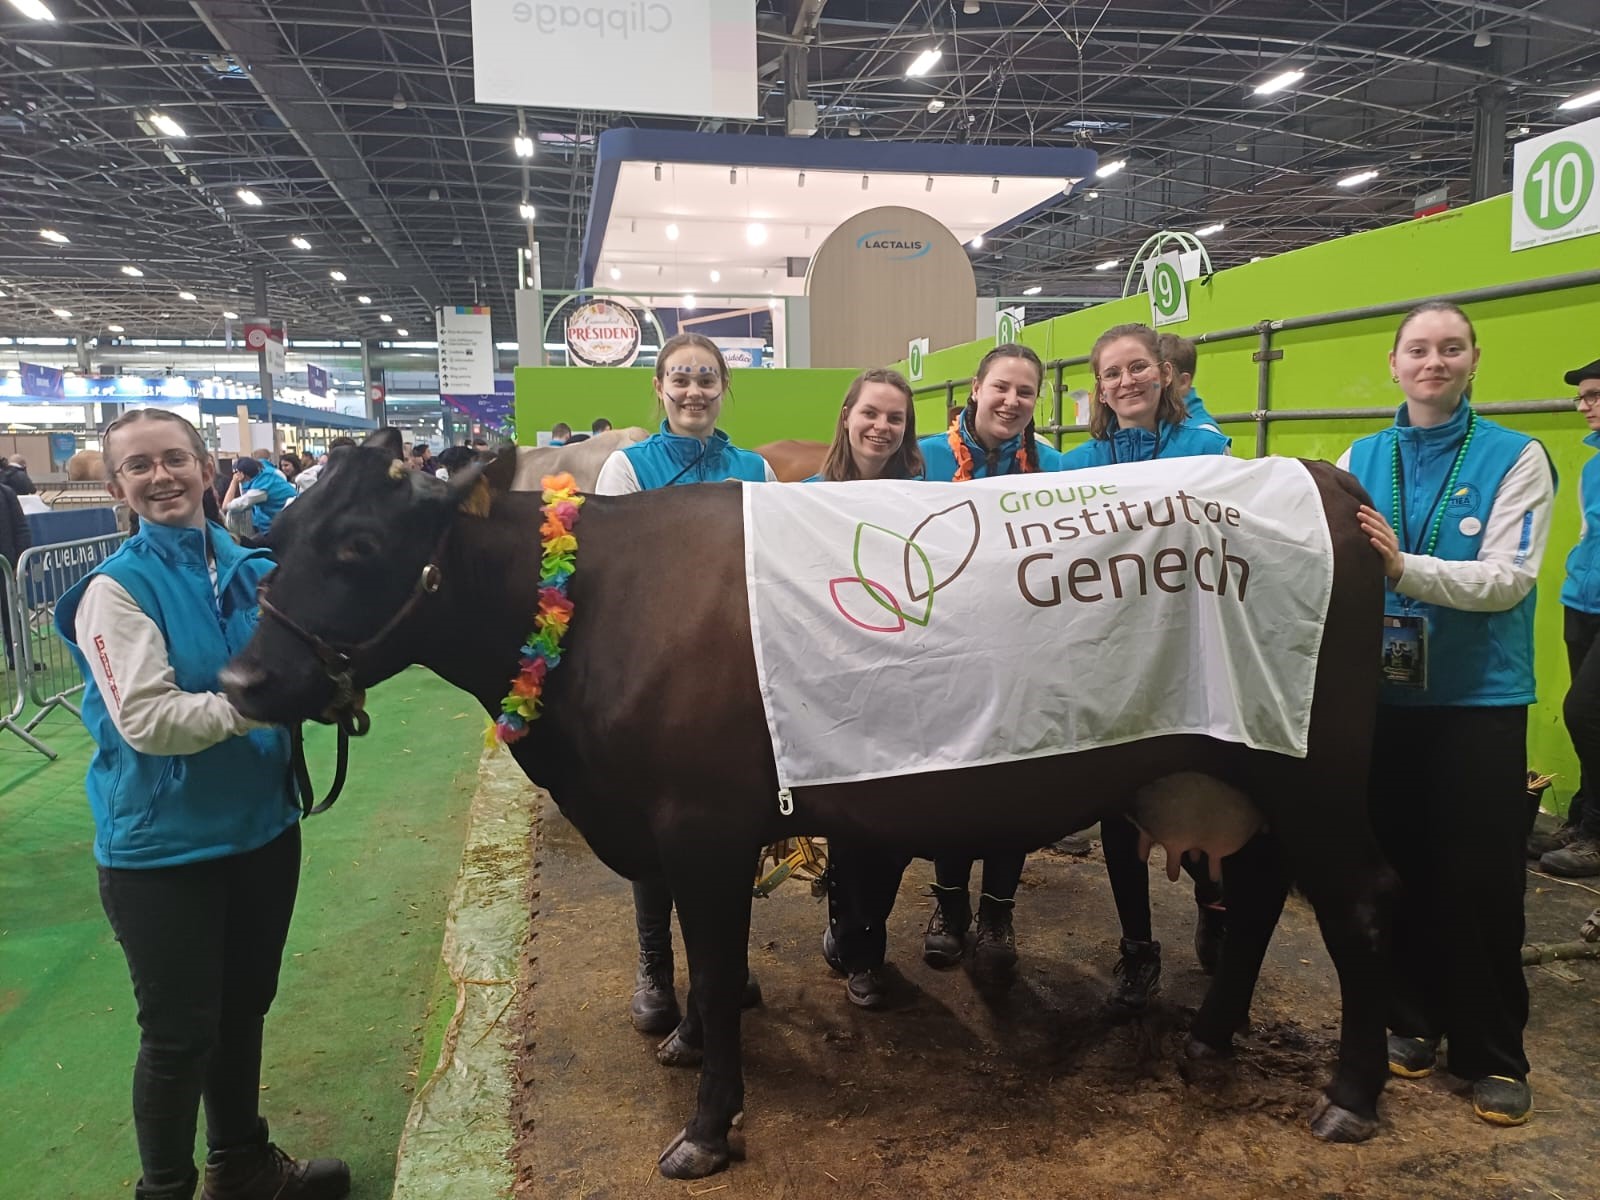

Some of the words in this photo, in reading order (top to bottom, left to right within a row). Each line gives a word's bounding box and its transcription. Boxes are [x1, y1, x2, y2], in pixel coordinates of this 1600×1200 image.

[1531, 152, 1584, 219] 10
[865, 240, 922, 250] LACTALIS
[1158, 270, 1173, 308] 9
[567, 325, 637, 342] PRÉSIDENT
[1001, 319, 1009, 345] 8
[912, 348, 918, 375] 7
[1000, 484, 1118, 514] Groupe
[1005, 490, 1200, 550] Institut
[1204, 500, 1241, 528] de
[1017, 537, 1250, 608] Genech
